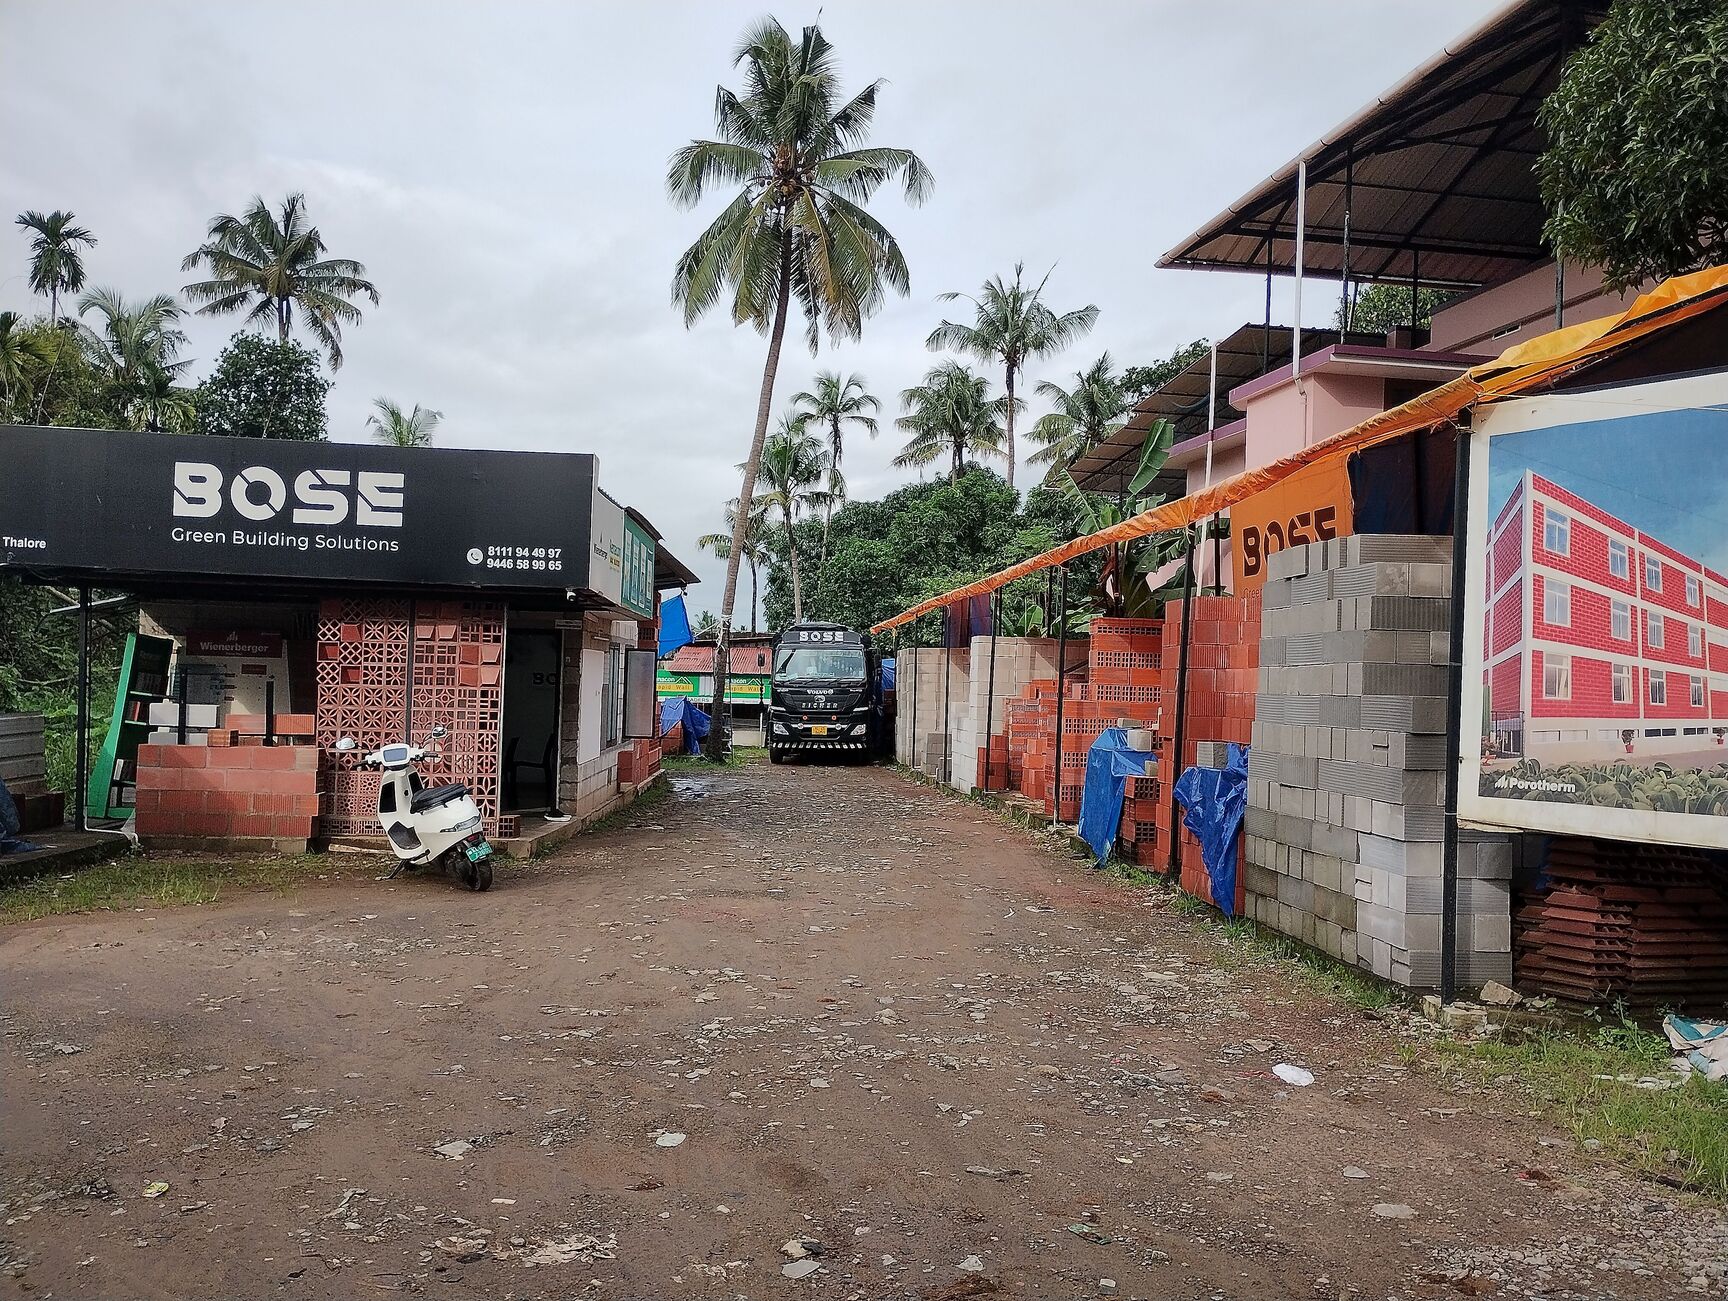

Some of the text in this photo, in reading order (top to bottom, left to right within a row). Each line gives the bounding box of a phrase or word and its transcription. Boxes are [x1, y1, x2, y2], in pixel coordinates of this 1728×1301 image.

[173, 461, 405, 528] BOSE
[3, 537, 46, 548] Thalore
[172, 528, 400, 553] Green Building Solutions
[488, 546, 562, 559] 8111 94 49 97
[486, 558, 562, 571] 9446 58 99 65
[799, 631, 844, 642] BOSE
[199, 642, 269, 653] Wienerberger
[1509, 777, 1576, 793] Porotherm
